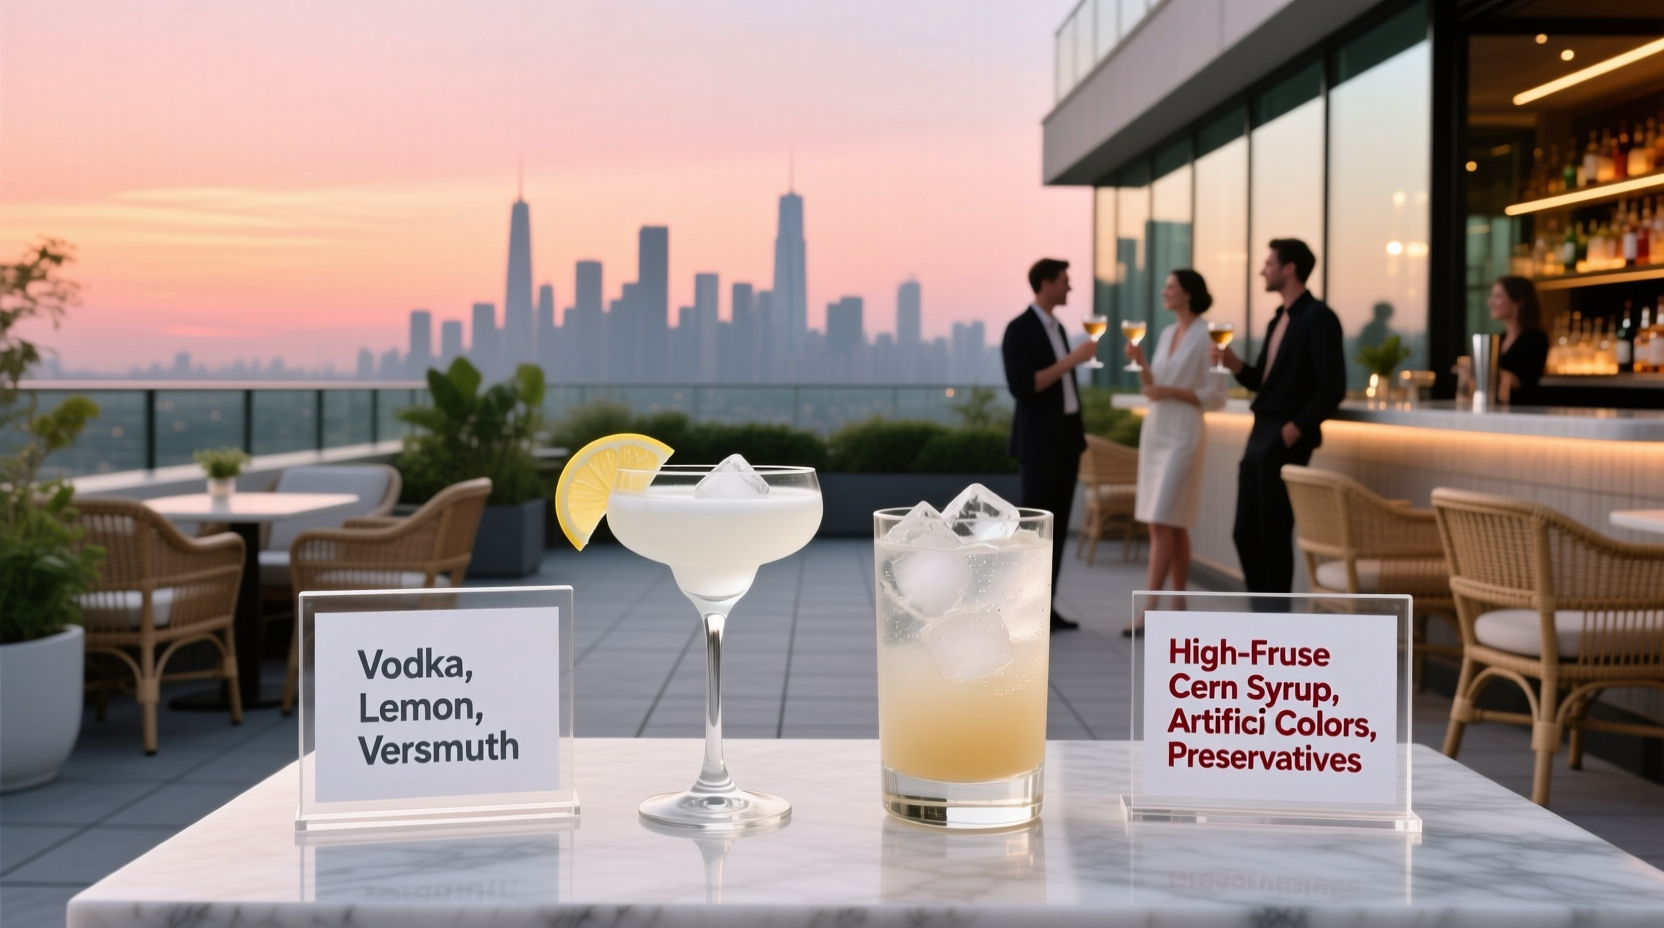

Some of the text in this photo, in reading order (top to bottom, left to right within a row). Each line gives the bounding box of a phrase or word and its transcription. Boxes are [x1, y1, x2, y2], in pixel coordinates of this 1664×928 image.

[357, 647, 473, 684] Vodka,
[1169, 637, 1331, 672] High-Fruse
[1168, 672, 1340, 708] Cern Syrup,
[359, 692, 484, 726] Lemon,
[1167, 707, 1377, 743] Artifici Colors,
[357, 729, 519, 766] Versmuth
[1168, 741, 1363, 773] Preservatives
